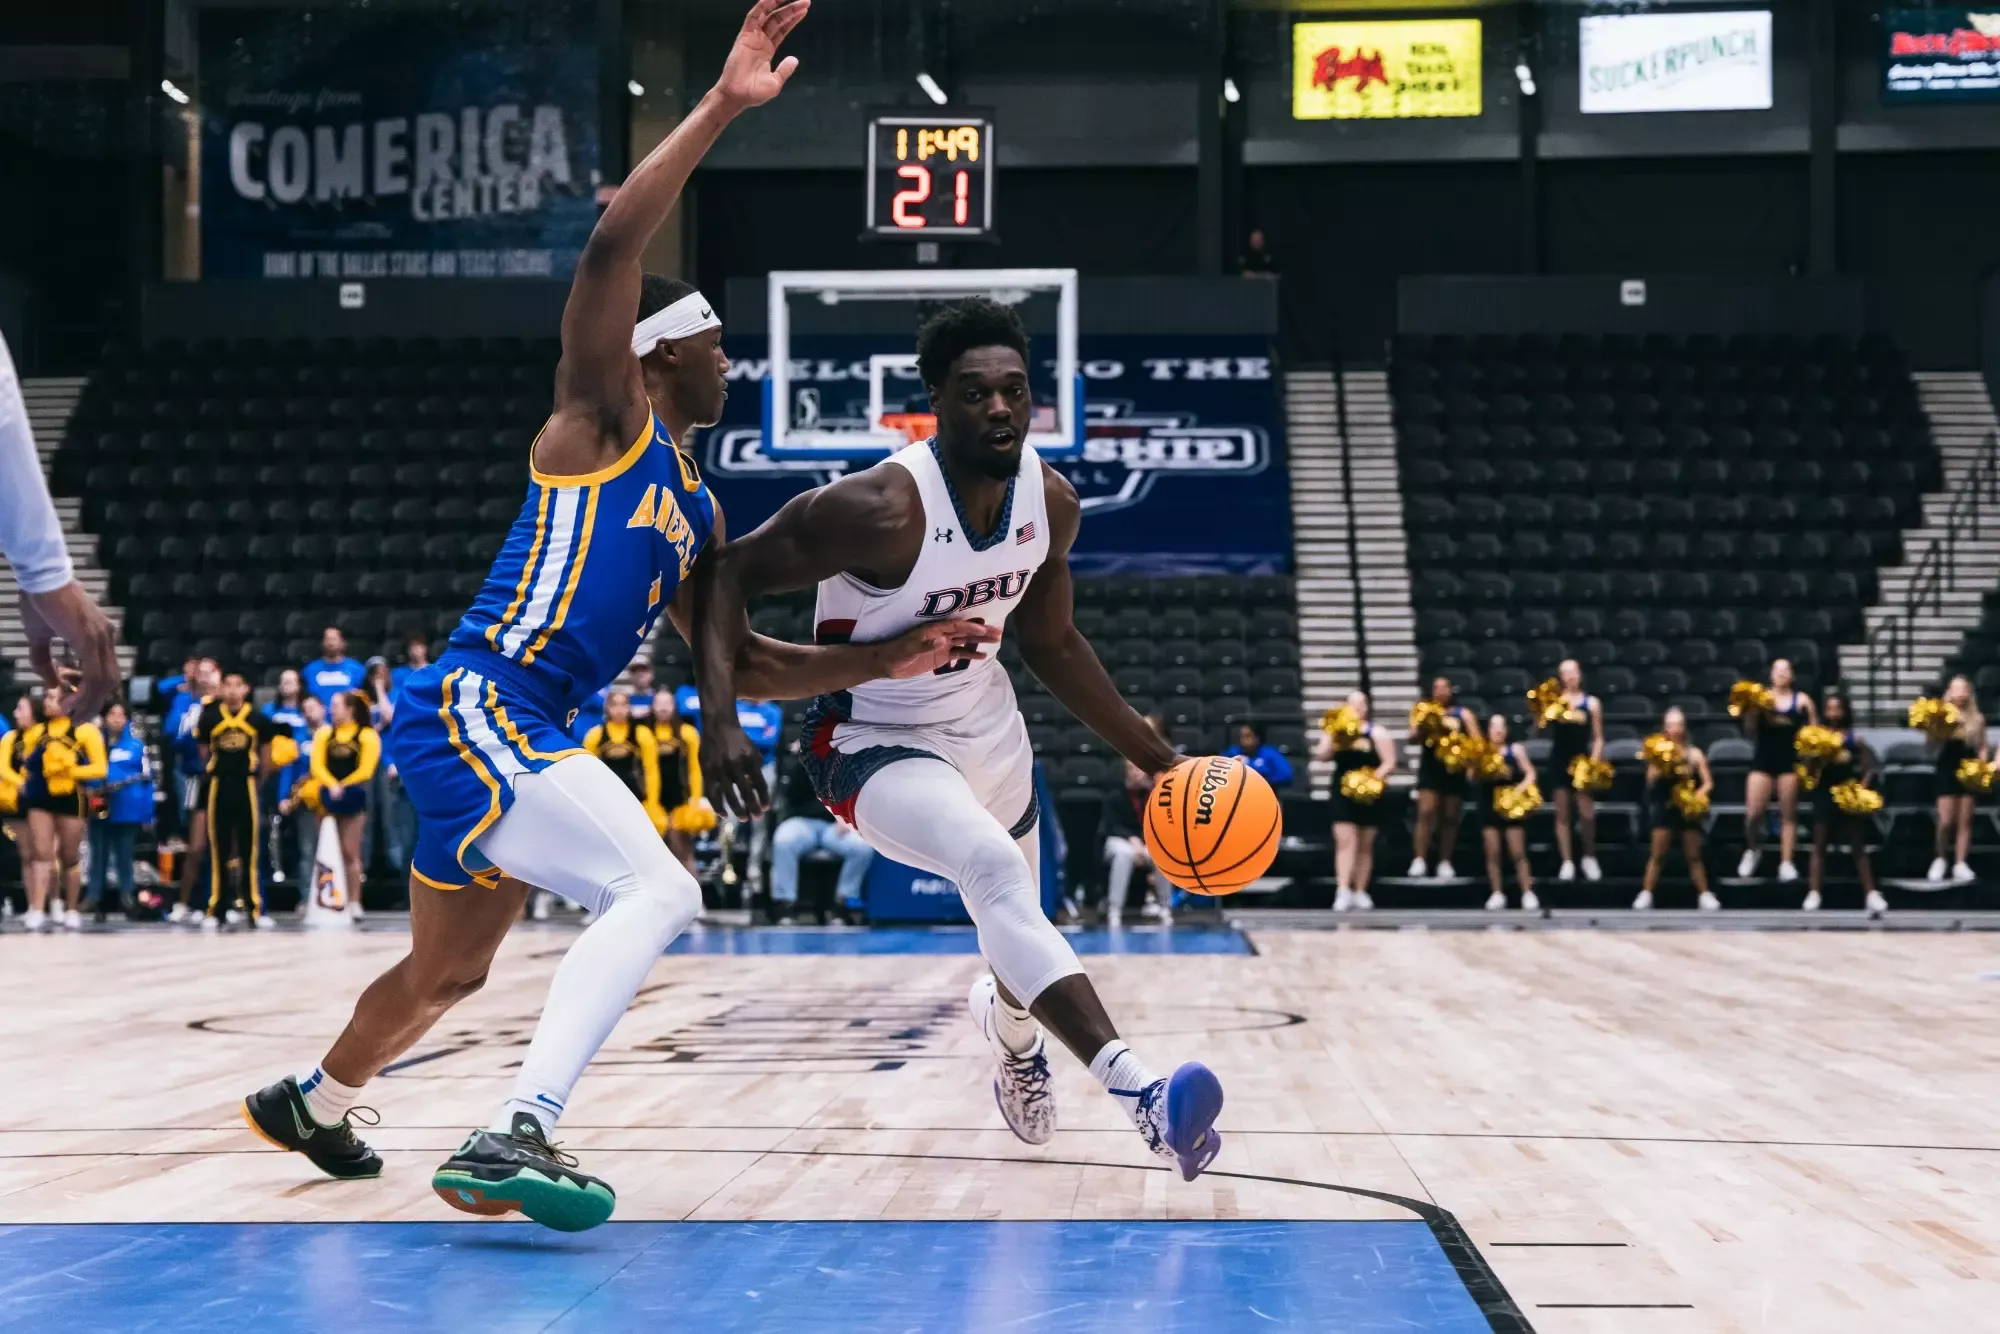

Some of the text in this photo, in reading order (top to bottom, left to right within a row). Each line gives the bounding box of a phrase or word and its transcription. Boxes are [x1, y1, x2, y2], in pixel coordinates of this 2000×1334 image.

[1589, 29, 1757, 93] SUCKERPUNCH
[228, 104, 572, 205] COMERICA
[897, 127, 979, 162] 11:49
[411, 170, 542, 222] CENTER
[892, 163, 969, 228] 21
[1142, 357, 1270, 381] THE
[626, 484, 697, 582] ANGEL
[915, 569, 1030, 618] DBU
[1195, 757, 1233, 825] Wilson
